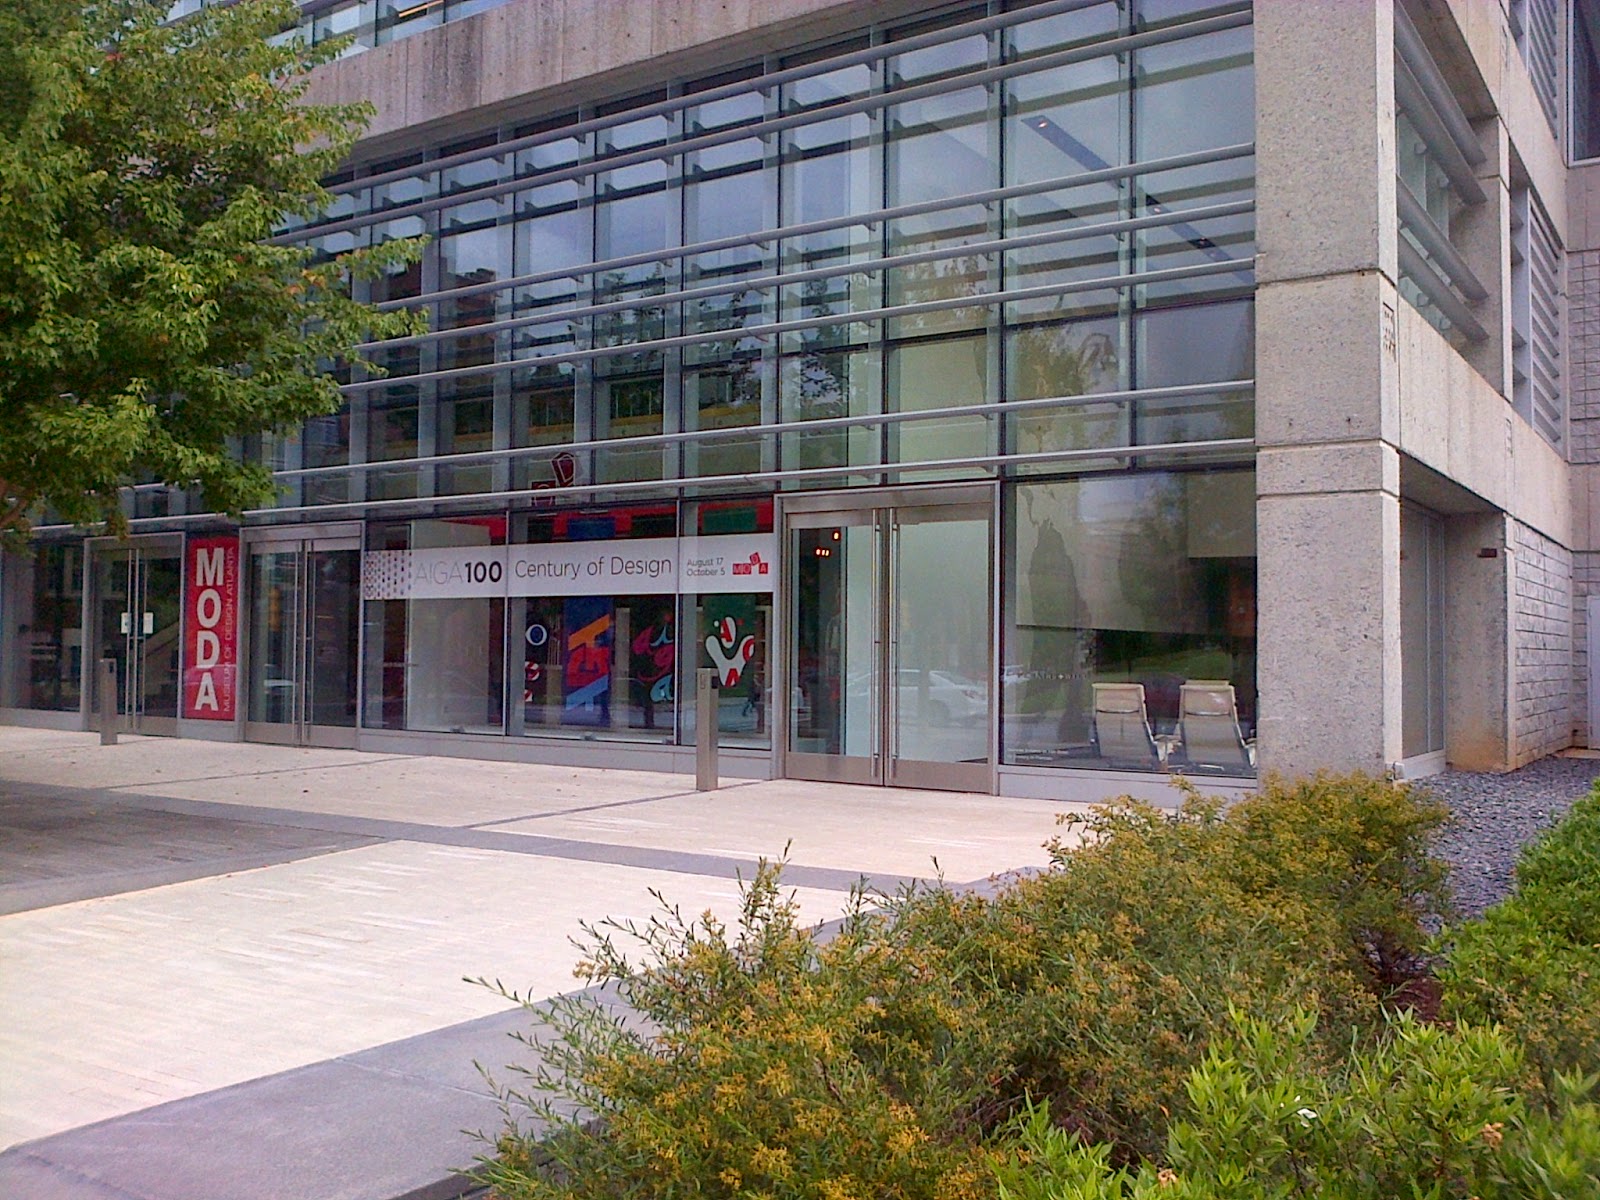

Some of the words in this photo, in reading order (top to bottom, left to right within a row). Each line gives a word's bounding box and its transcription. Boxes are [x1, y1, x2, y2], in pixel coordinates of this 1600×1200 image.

[225, 546, 235, 596] ATLANTA
[515, 559, 580, 580] Century
[587, 556, 604, 576] of
[610, 556, 672, 578] Design
[686, 568, 718, 577] October
[720, 567, 726, 576] 5
[687, 558, 714, 568] August
[716, 557, 724, 565] 17
[195, 547, 225, 711] MODA
[225, 598, 233, 640] DESIGN
[224, 644, 232, 659] OF
[223, 661, 232, 712] MUSEUM
